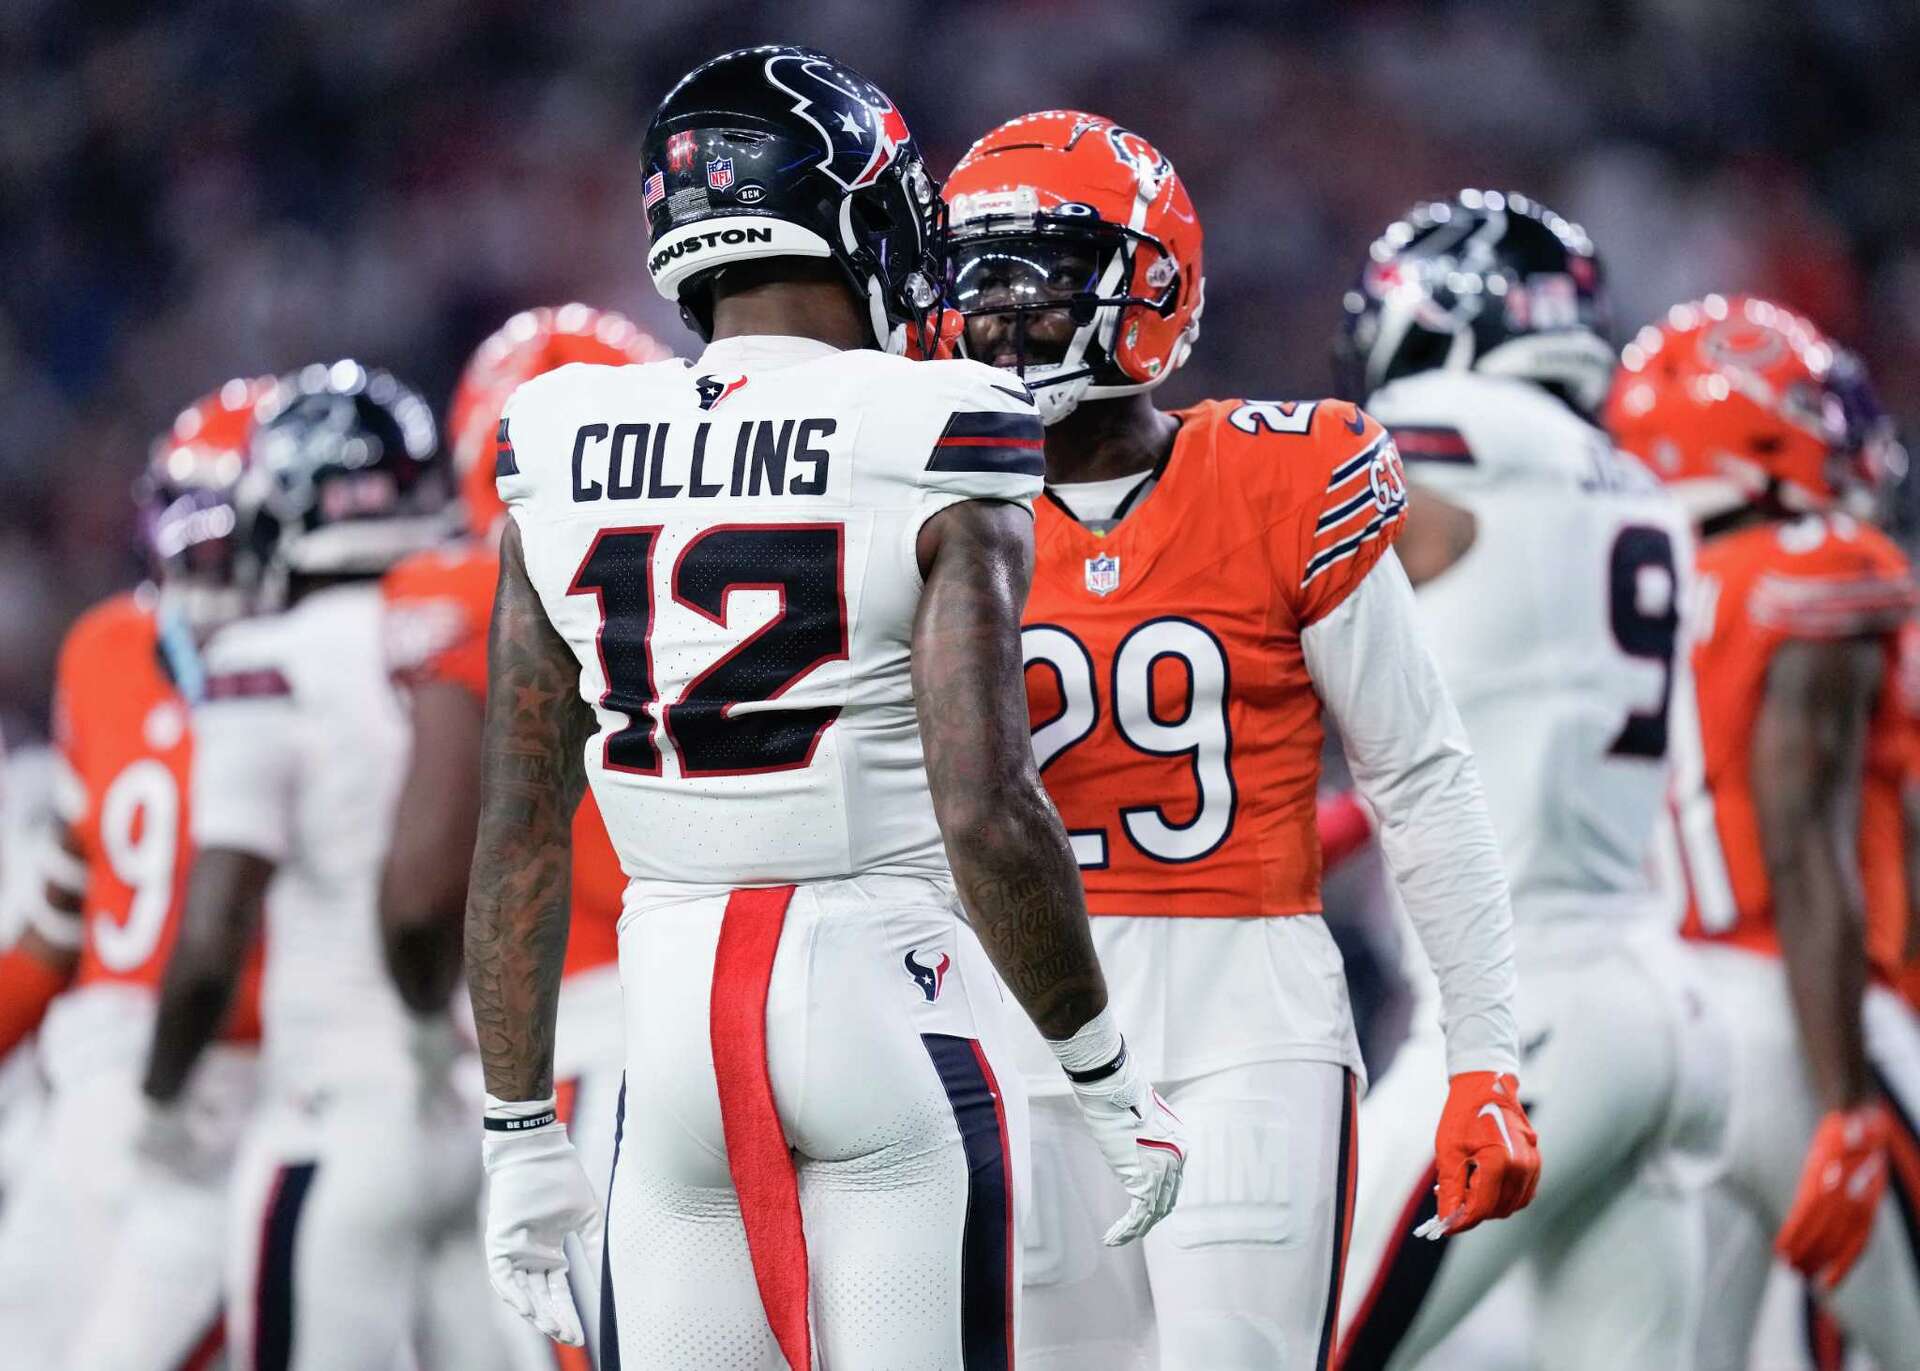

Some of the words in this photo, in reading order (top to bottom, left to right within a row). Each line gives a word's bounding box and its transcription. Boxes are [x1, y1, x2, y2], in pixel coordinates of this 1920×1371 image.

[709, 169, 733, 188] NFL
[649, 228, 772, 276] HOUSTON
[572, 418, 837, 503] COLLINS
[565, 521, 849, 779] 12
[1020, 615, 1238, 871] 29
[91, 757, 181, 974] 9
[506, 1120, 521, 1129] BE
[522, 1113, 554, 1128] BETTER
